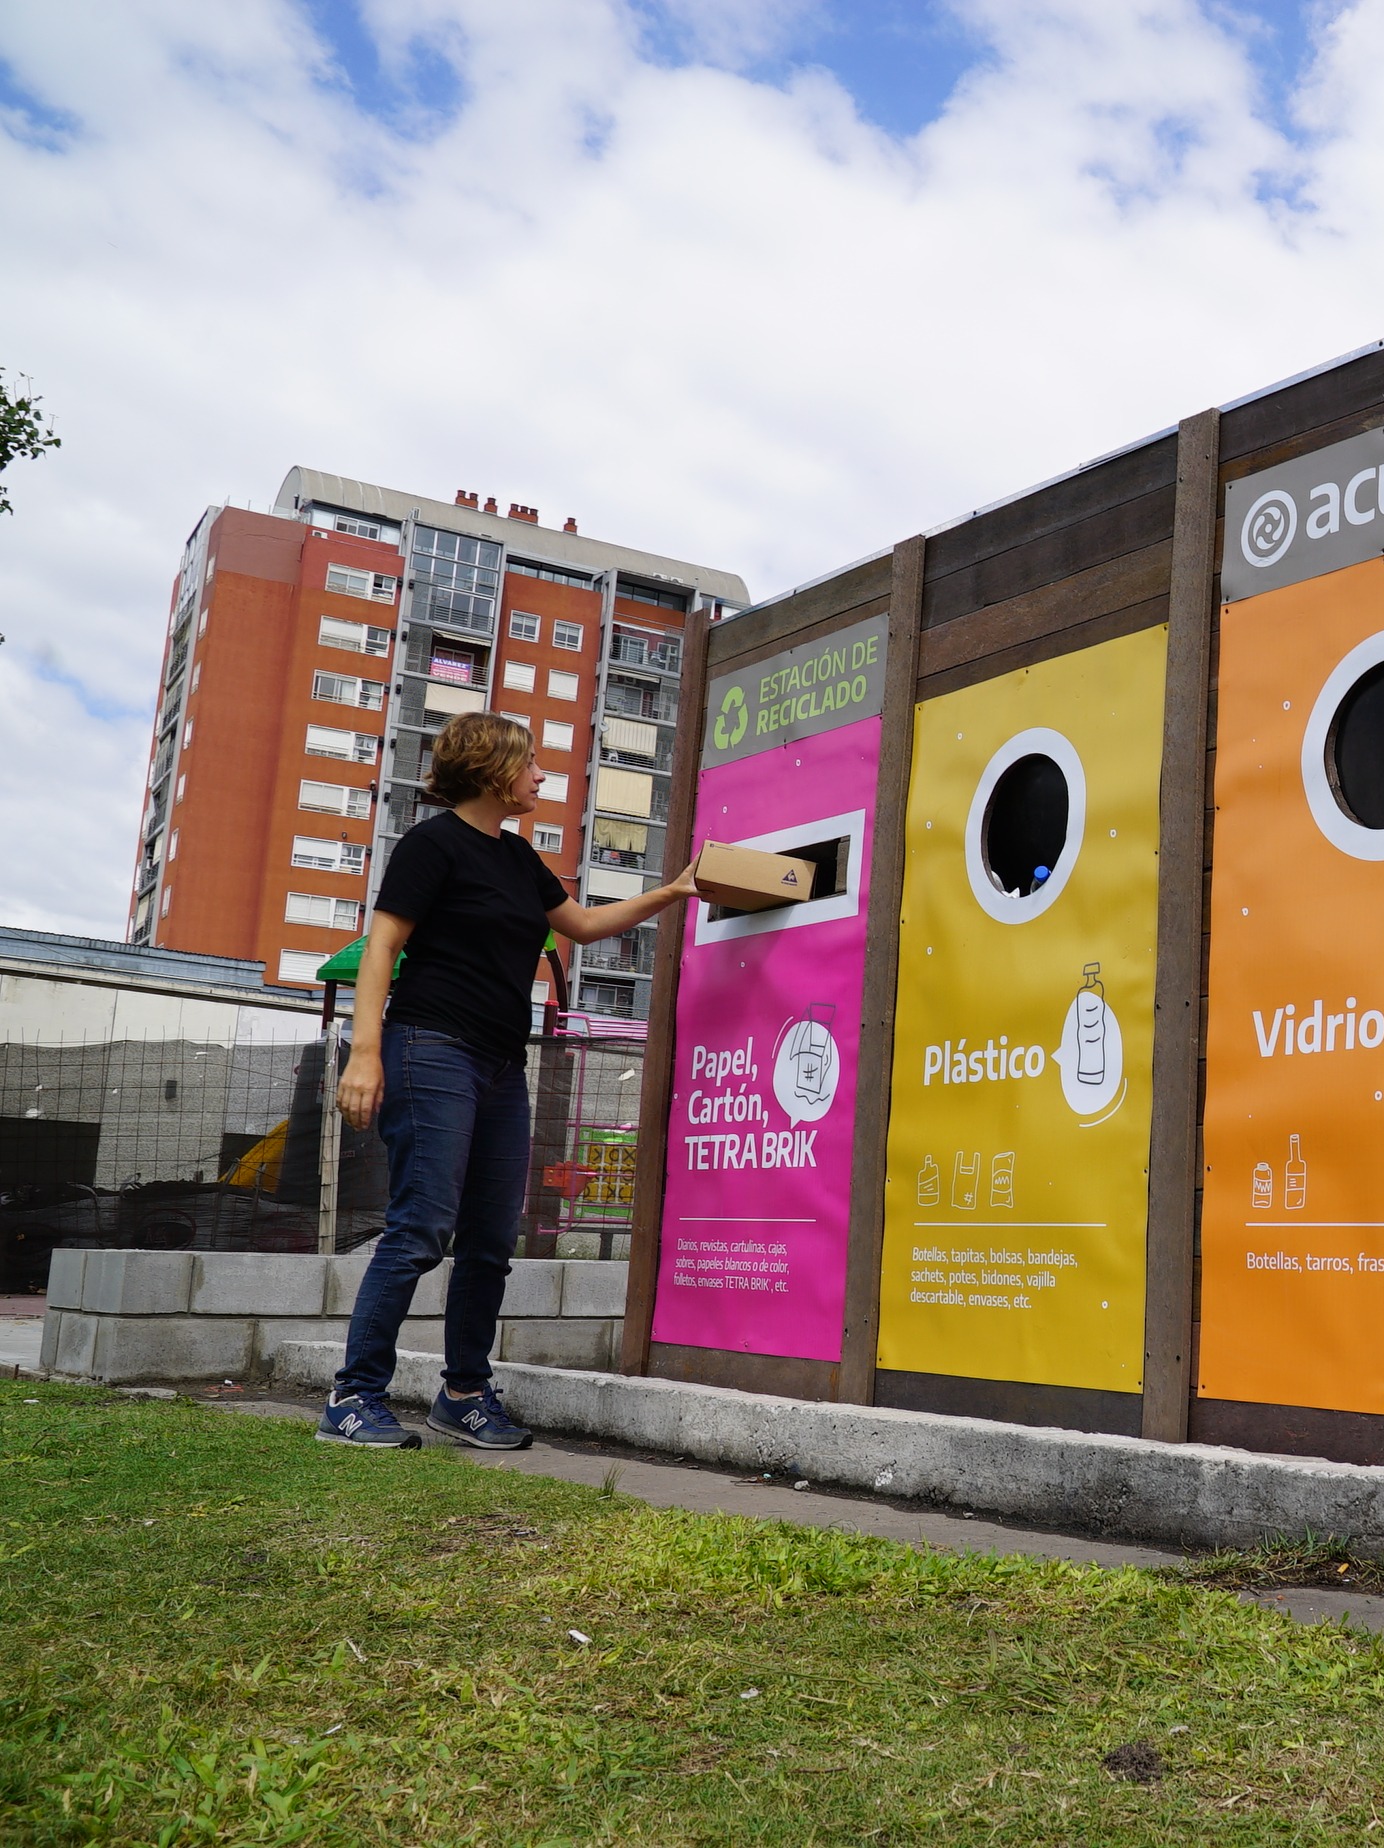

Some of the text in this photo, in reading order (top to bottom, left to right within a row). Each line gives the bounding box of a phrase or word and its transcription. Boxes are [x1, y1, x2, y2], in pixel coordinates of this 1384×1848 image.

[759, 636, 878, 703] ESTACIÓN DE
[756, 674, 867, 736] RECICLADO
[691, 1036, 758, 1087] Papel,
[923, 1035, 1045, 1086] Plástico
[688, 1083, 769, 1128] Cartón,
[685, 1130, 818, 1171] TETRA BRIK
[677, 1238, 788, 1256] Diarios, revistas, cartulinas, cajas,
[912, 1246, 1078, 1269] Botellas, tapitas, bolsas, bandejas,
[675, 1255, 790, 1275] sobres, papeles blancos o de color,
[1246, 1251, 1302, 1274] Botellas,
[1305, 1252, 1354, 1275] tarros,
[673, 1272, 698, 1288] folletos,
[698, 1277, 724, 1288] envases
[725, 1275, 750, 1289] TETRA
[774, 1279, 789, 1292] etc.
[911, 1267, 1056, 1291] sachets, potes, bidones, vajilla
[910, 1286, 1032, 1310] descartable, envases, etc.
